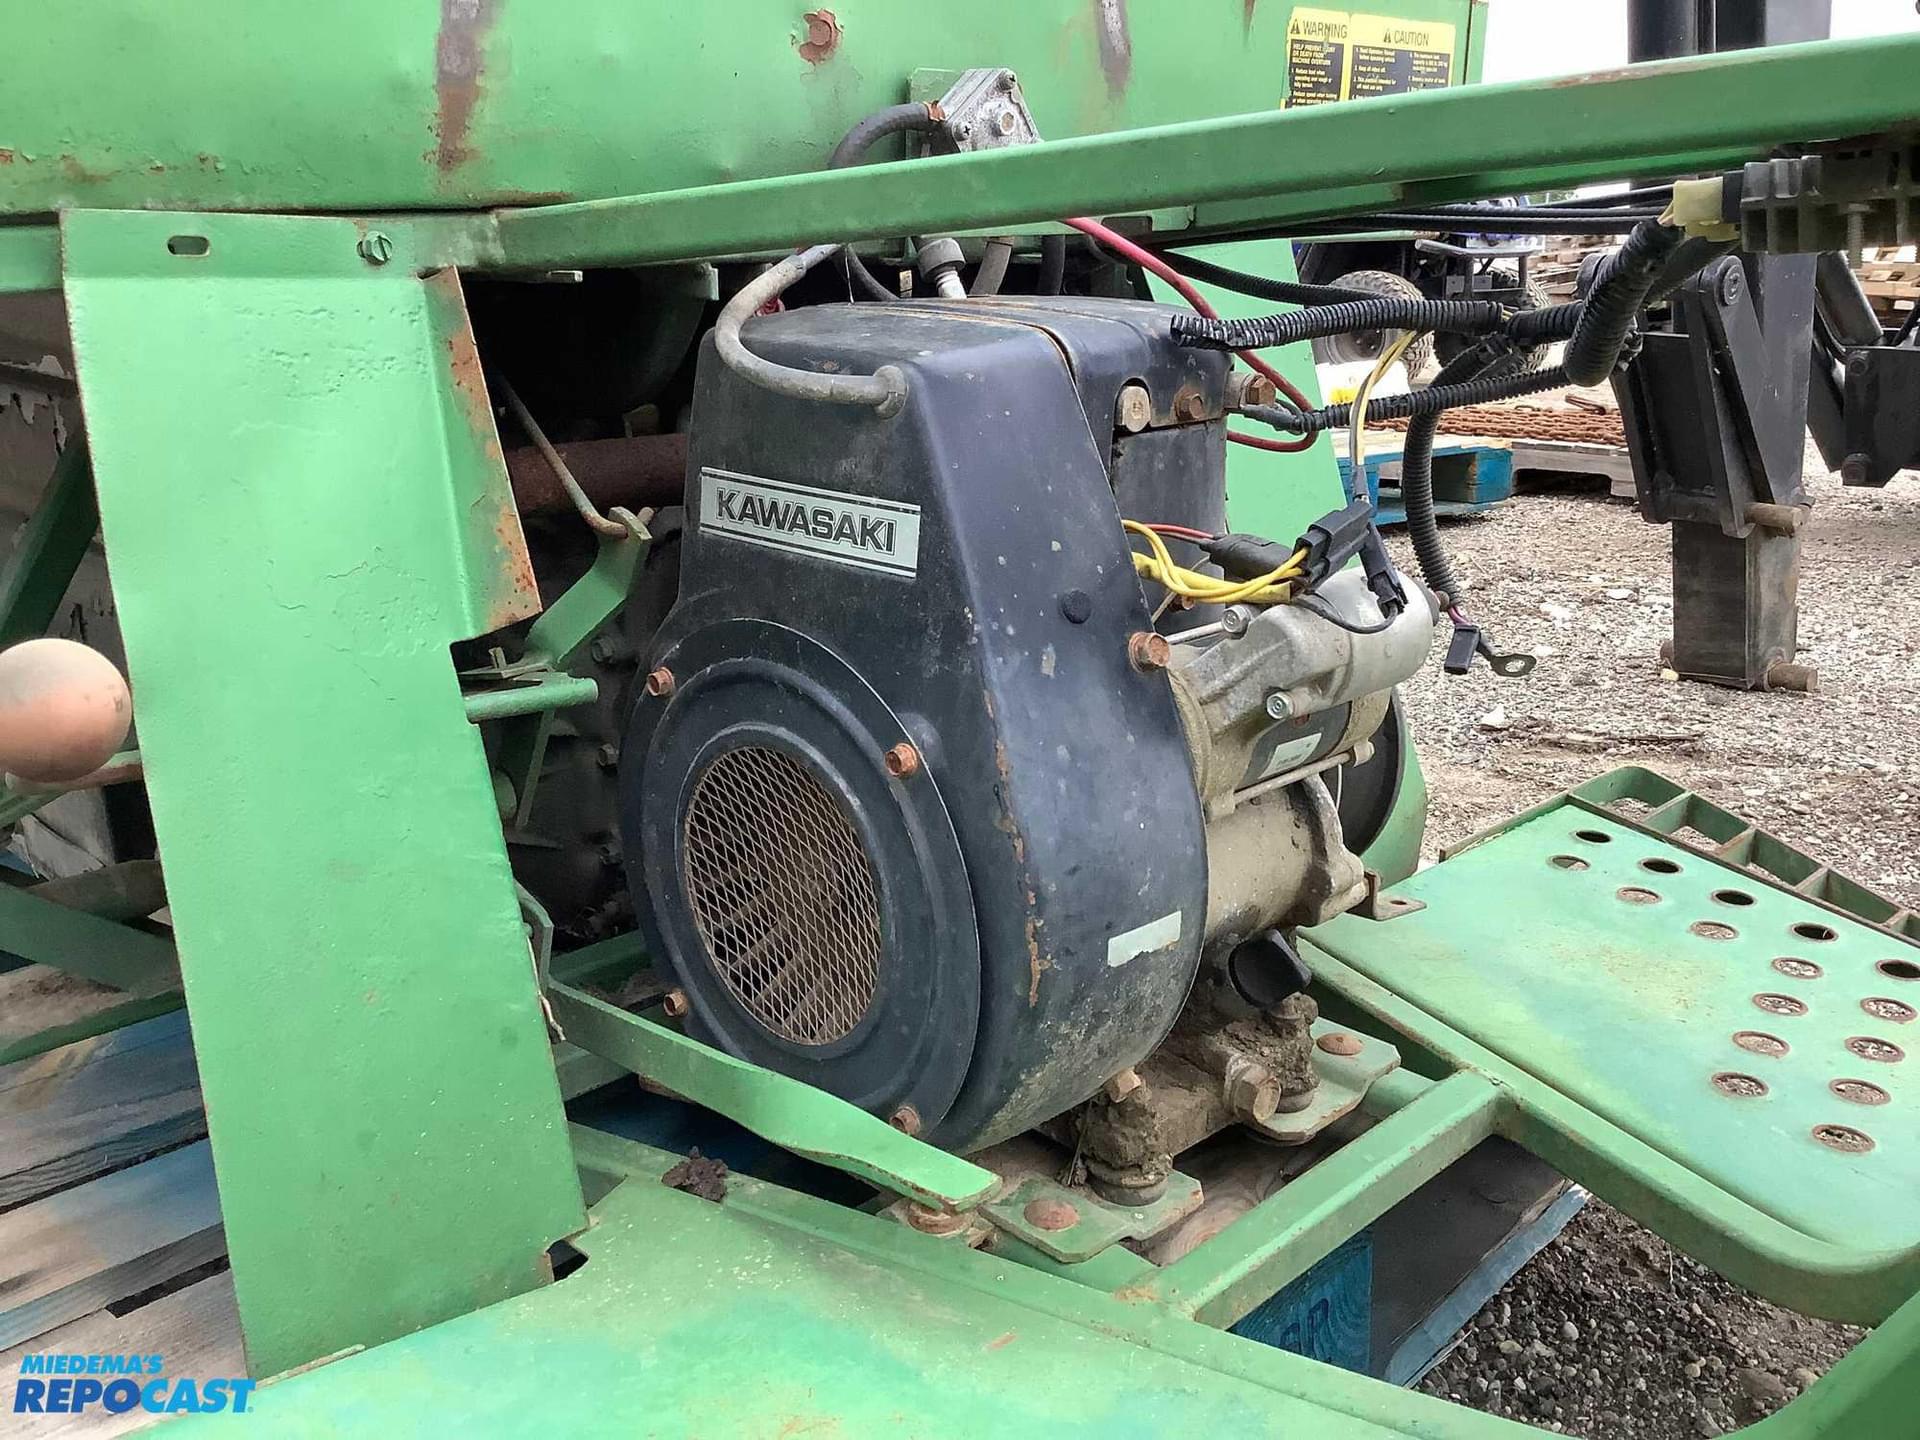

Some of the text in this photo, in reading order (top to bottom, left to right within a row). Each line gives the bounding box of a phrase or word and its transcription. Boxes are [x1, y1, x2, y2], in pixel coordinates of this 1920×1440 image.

[1302, 20, 1348, 39] WARNING
[1394, 30, 1429, 47] CAUTION
[717, 488, 896, 555] KAWASAKI
